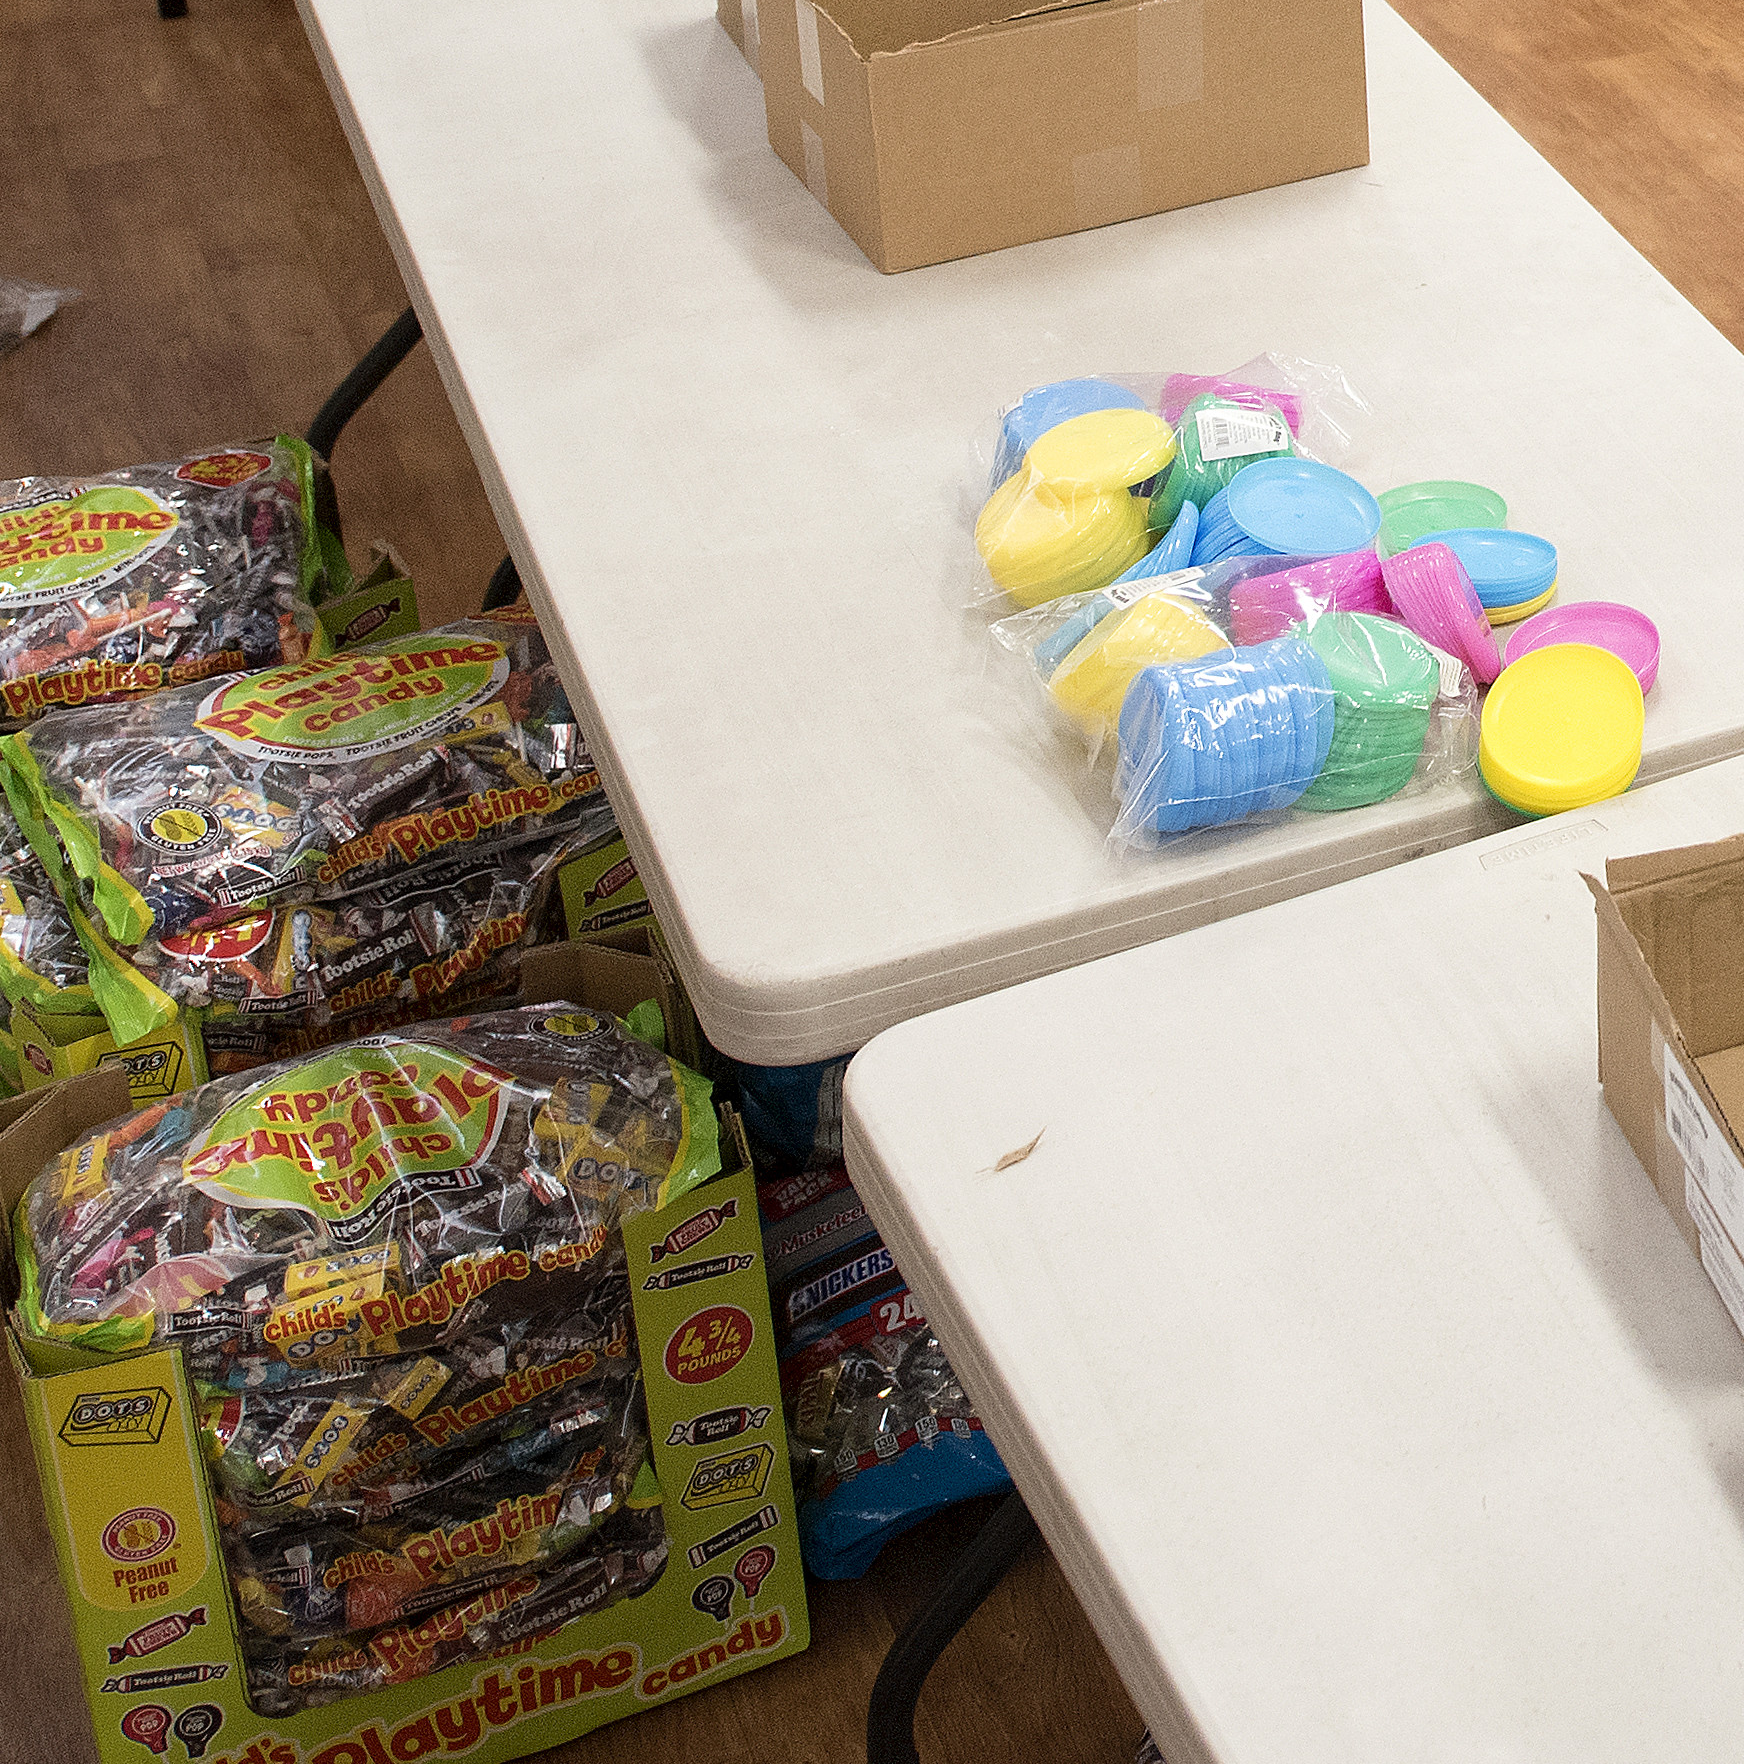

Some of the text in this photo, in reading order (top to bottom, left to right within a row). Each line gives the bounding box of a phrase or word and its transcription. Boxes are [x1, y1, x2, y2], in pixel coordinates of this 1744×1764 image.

[5, 650, 245, 714] Playtime candy
[196, 641, 501, 739] Playtime
[303, 676, 446, 734] candy
[395, 723, 424, 747] FRUIT
[317, 771, 602, 884] child's Playtime can
[230, 877, 273, 900] Tootsie
[329, 909, 528, 1014] child's Playtim
[187, 1056, 514, 1180] Playtime
[261, 1064, 419, 1123] candy
[313, 1131, 452, 1214] child's
[264, 1303, 347, 1343] child's
[361, 1247, 531, 1339] Playtime
[788, 1247, 895, 1323] SNICKERS
[676, 1324, 707, 1357] 4
[676, 1343, 742, 1378] POUNDS
[73, 1395, 152, 1425] DOTS
[332, 1350, 597, 1488] child's Playtime
[699, 1415, 741, 1431] Tootsie
[695, 1453, 759, 1489] DOTS
[322, 1490, 563, 1590] child's Playtim
[113, 1556, 180, 1589] Peanut
[128, 1580, 170, 1605] Free
[370, 1572, 542, 1673] Playtime
[132, 1670, 199, 1688] Tootsie Roll
[641, 1610, 784, 1698] candy
